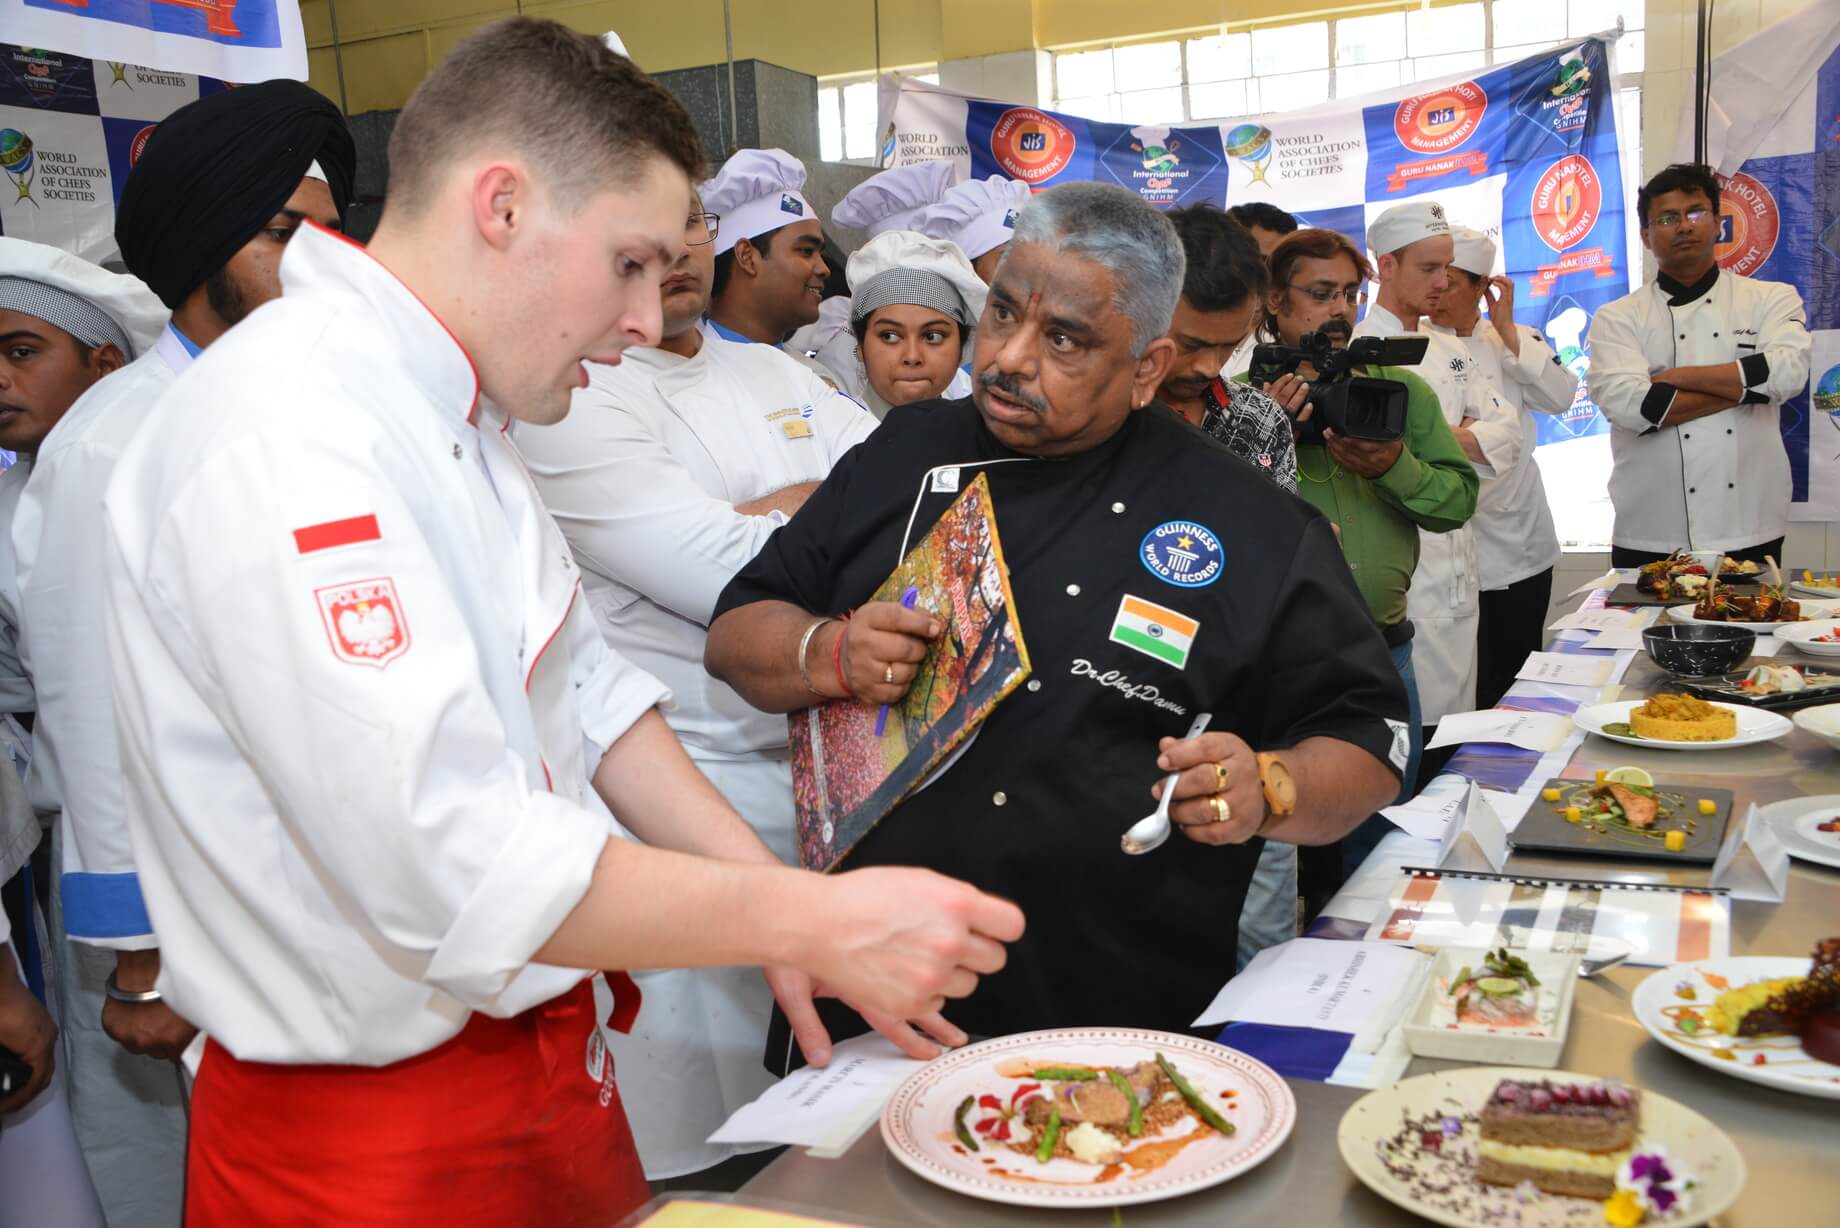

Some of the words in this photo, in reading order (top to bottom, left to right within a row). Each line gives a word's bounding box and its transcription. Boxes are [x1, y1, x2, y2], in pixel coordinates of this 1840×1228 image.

[136, 73, 186, 87] SOCIETIES
[1401, 98, 1418, 124] GURU
[998, 115, 1016, 138] GURU
[898, 133, 938, 143] WORLD
[1275, 134, 1324, 147] WORLD
[1411, 120, 1473, 148] MANAGEMENT
[901, 145, 968, 157] ASSOCIATION
[1278, 140, 1360, 159] ASSOCIATION
[36, 151, 77, 163] WORLD
[1280, 158, 1298, 169] OF
[1299, 155, 1339, 167] CHEFS
[39, 165, 107, 178] ASSOCIATION
[1003, 155, 1062, 179] MANAGEMENT
[1133, 169, 1189, 178] International
[1281, 165, 1343, 179] SOCIETIES
[1400, 167, 1424, 177] GURU
[1424, 160, 1454, 172] NANAK
[41, 176, 55, 187] OF
[57, 178, 91, 189] CHEFS
[43, 189, 96, 201] SOCIETIES
[1538, 176, 1557, 209] GURU
[1735, 183, 1767, 219] HOTEL
[1155, 523, 1218, 552] GUINNESS
[1144, 543, 1169, 575] WORLD
[1173, 560, 1219, 583] RECORDS
